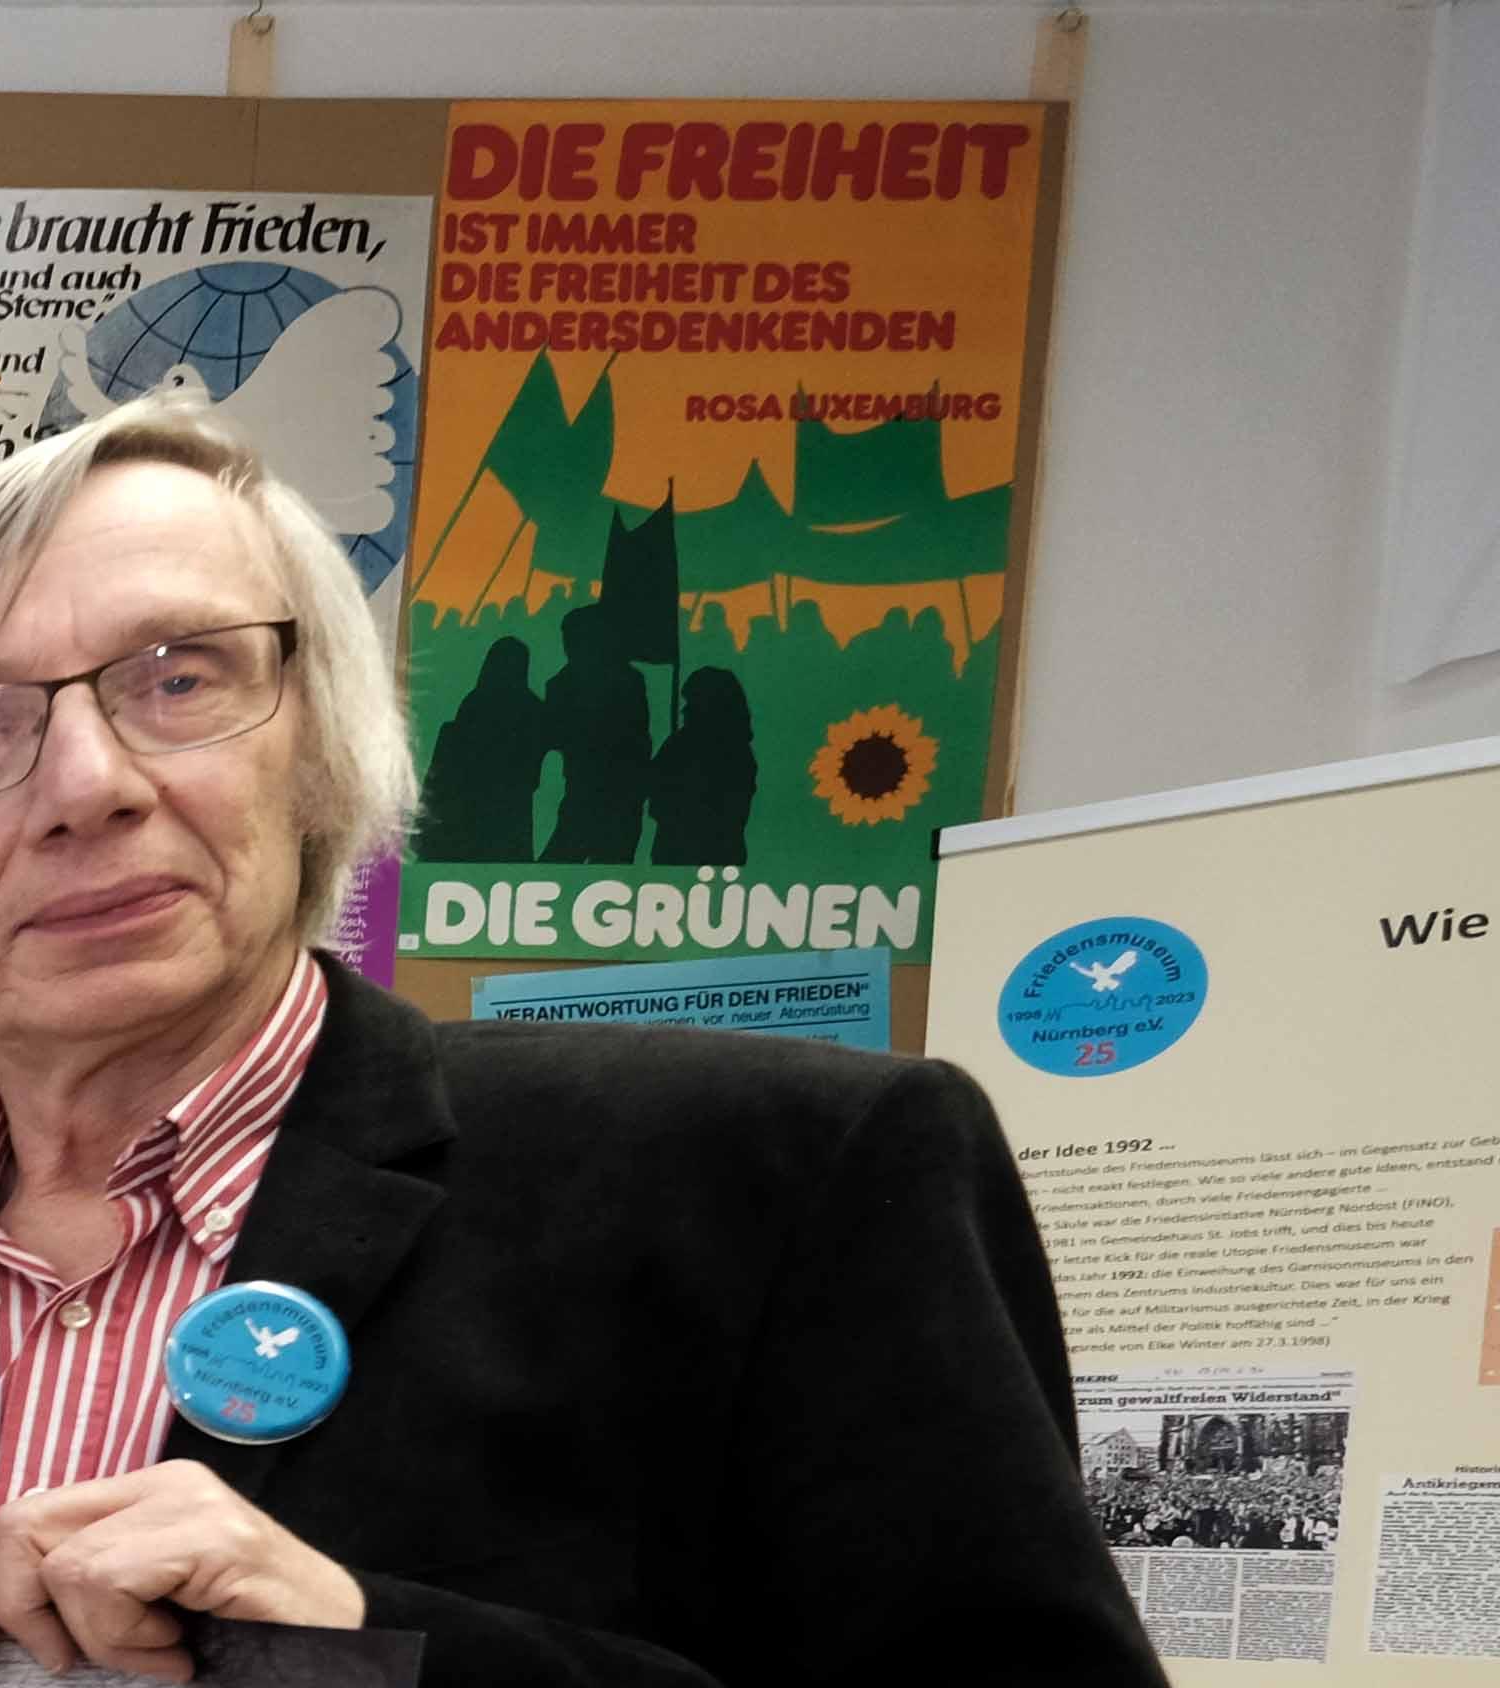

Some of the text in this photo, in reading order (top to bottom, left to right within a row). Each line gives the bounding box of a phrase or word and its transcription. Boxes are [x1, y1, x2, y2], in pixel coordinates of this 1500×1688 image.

[447, 122, 1031, 202] DIE FREIHEIT
[5, 201, 195, 256] braucht
[199, 201, 388, 261] Frieden,
[435, 310, 956, 353] ANDERSDENKENDEN
[684, 392, 1003, 423] ROSA LUXEMBURG
[424, 865, 921, 950] DIE GRÜNEN
[1379, 907, 1490, 949] Wie
[1073, 1041, 1117, 1067] 25
[1018, 1137, 1153, 1162] der Idee 1992
